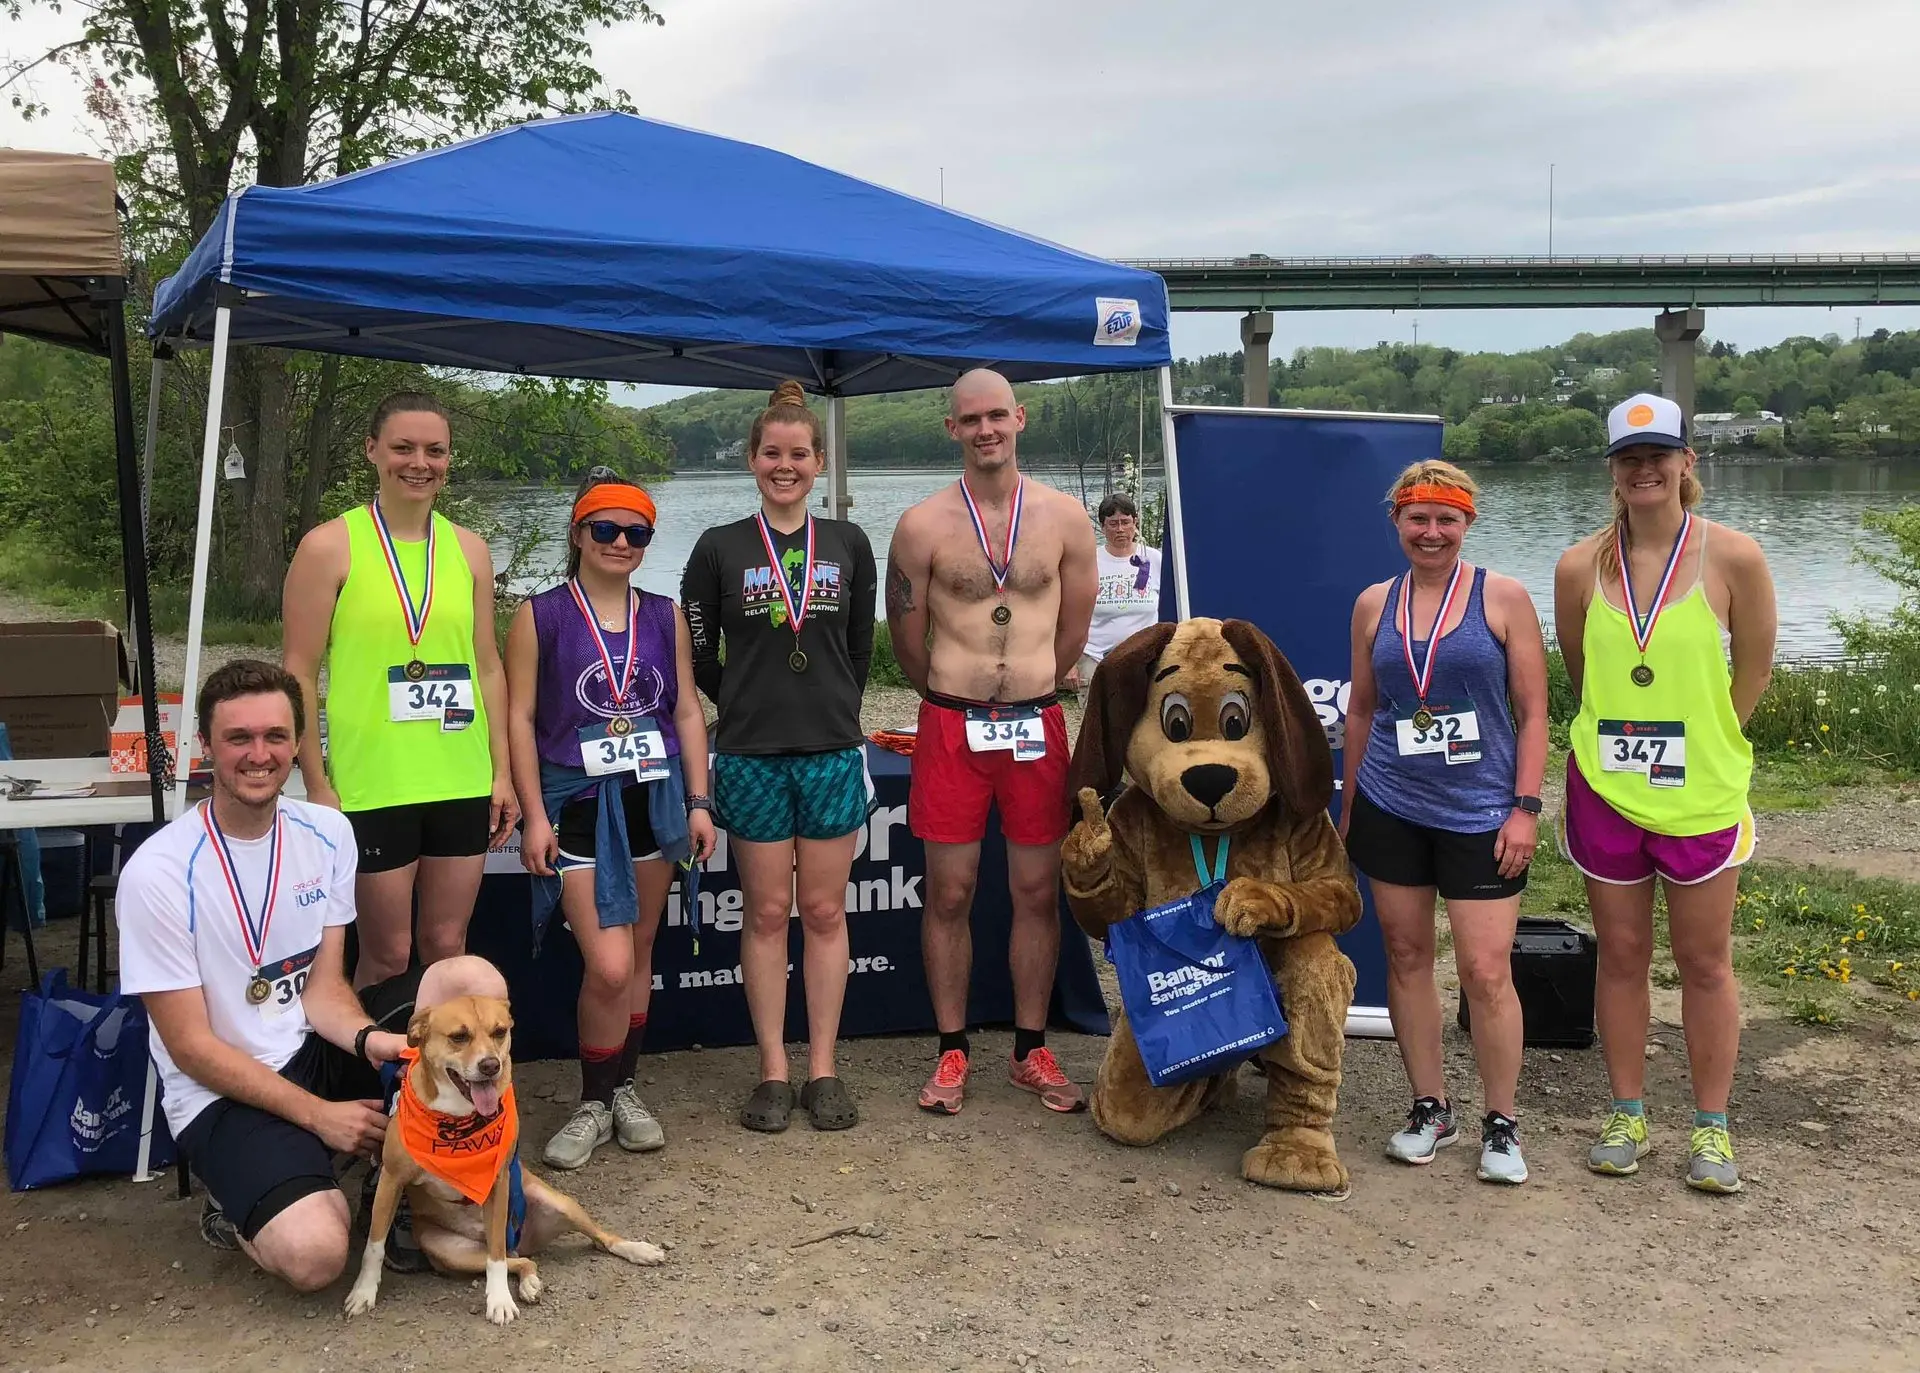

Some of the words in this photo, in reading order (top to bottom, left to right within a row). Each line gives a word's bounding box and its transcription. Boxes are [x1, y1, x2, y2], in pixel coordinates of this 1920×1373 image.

[743, 565, 840, 595] MNE
[746, 590, 838, 603] MARTHON
[744, 606, 770, 617] RELAY
[806, 604, 840, 612] ARATHON
[408, 683, 459, 709] 342
[982, 721, 1030, 741] 334
[599, 734, 651, 764] 345
[1613, 738, 1667, 763] 347
[298, 888, 327, 907] USA
[275, 971, 307, 1005] 30
[1150, 980, 1203, 1006] Savings
[1190, 1055, 1201, 1064] BE
[1207, 1041, 1238, 1058] PLASTIC
[1237, 1031, 1267, 1046] BOTTLE
